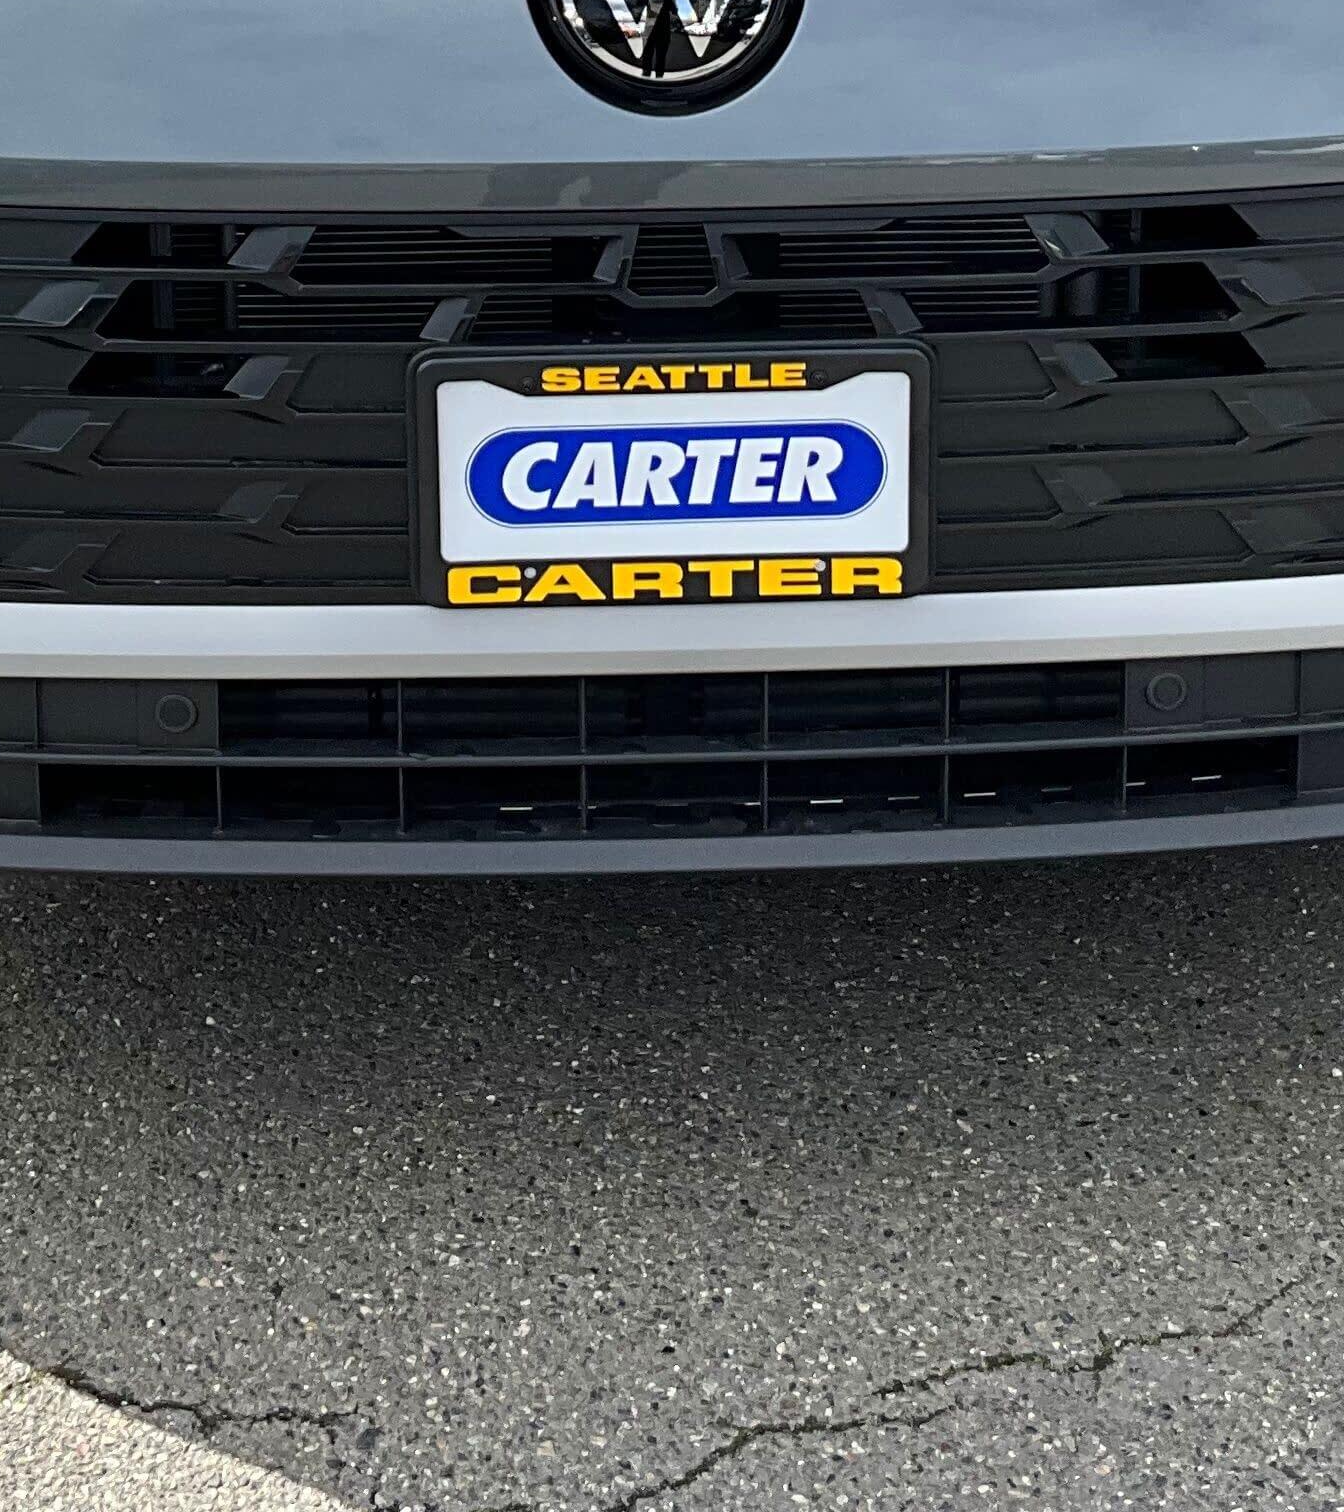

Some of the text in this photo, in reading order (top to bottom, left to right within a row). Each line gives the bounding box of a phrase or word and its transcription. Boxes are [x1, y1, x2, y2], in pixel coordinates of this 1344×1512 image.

[541, 362, 807, 393] SEATTLE
[501, 436, 844, 511] CARTER
[447, 557, 904, 605] CARTER
